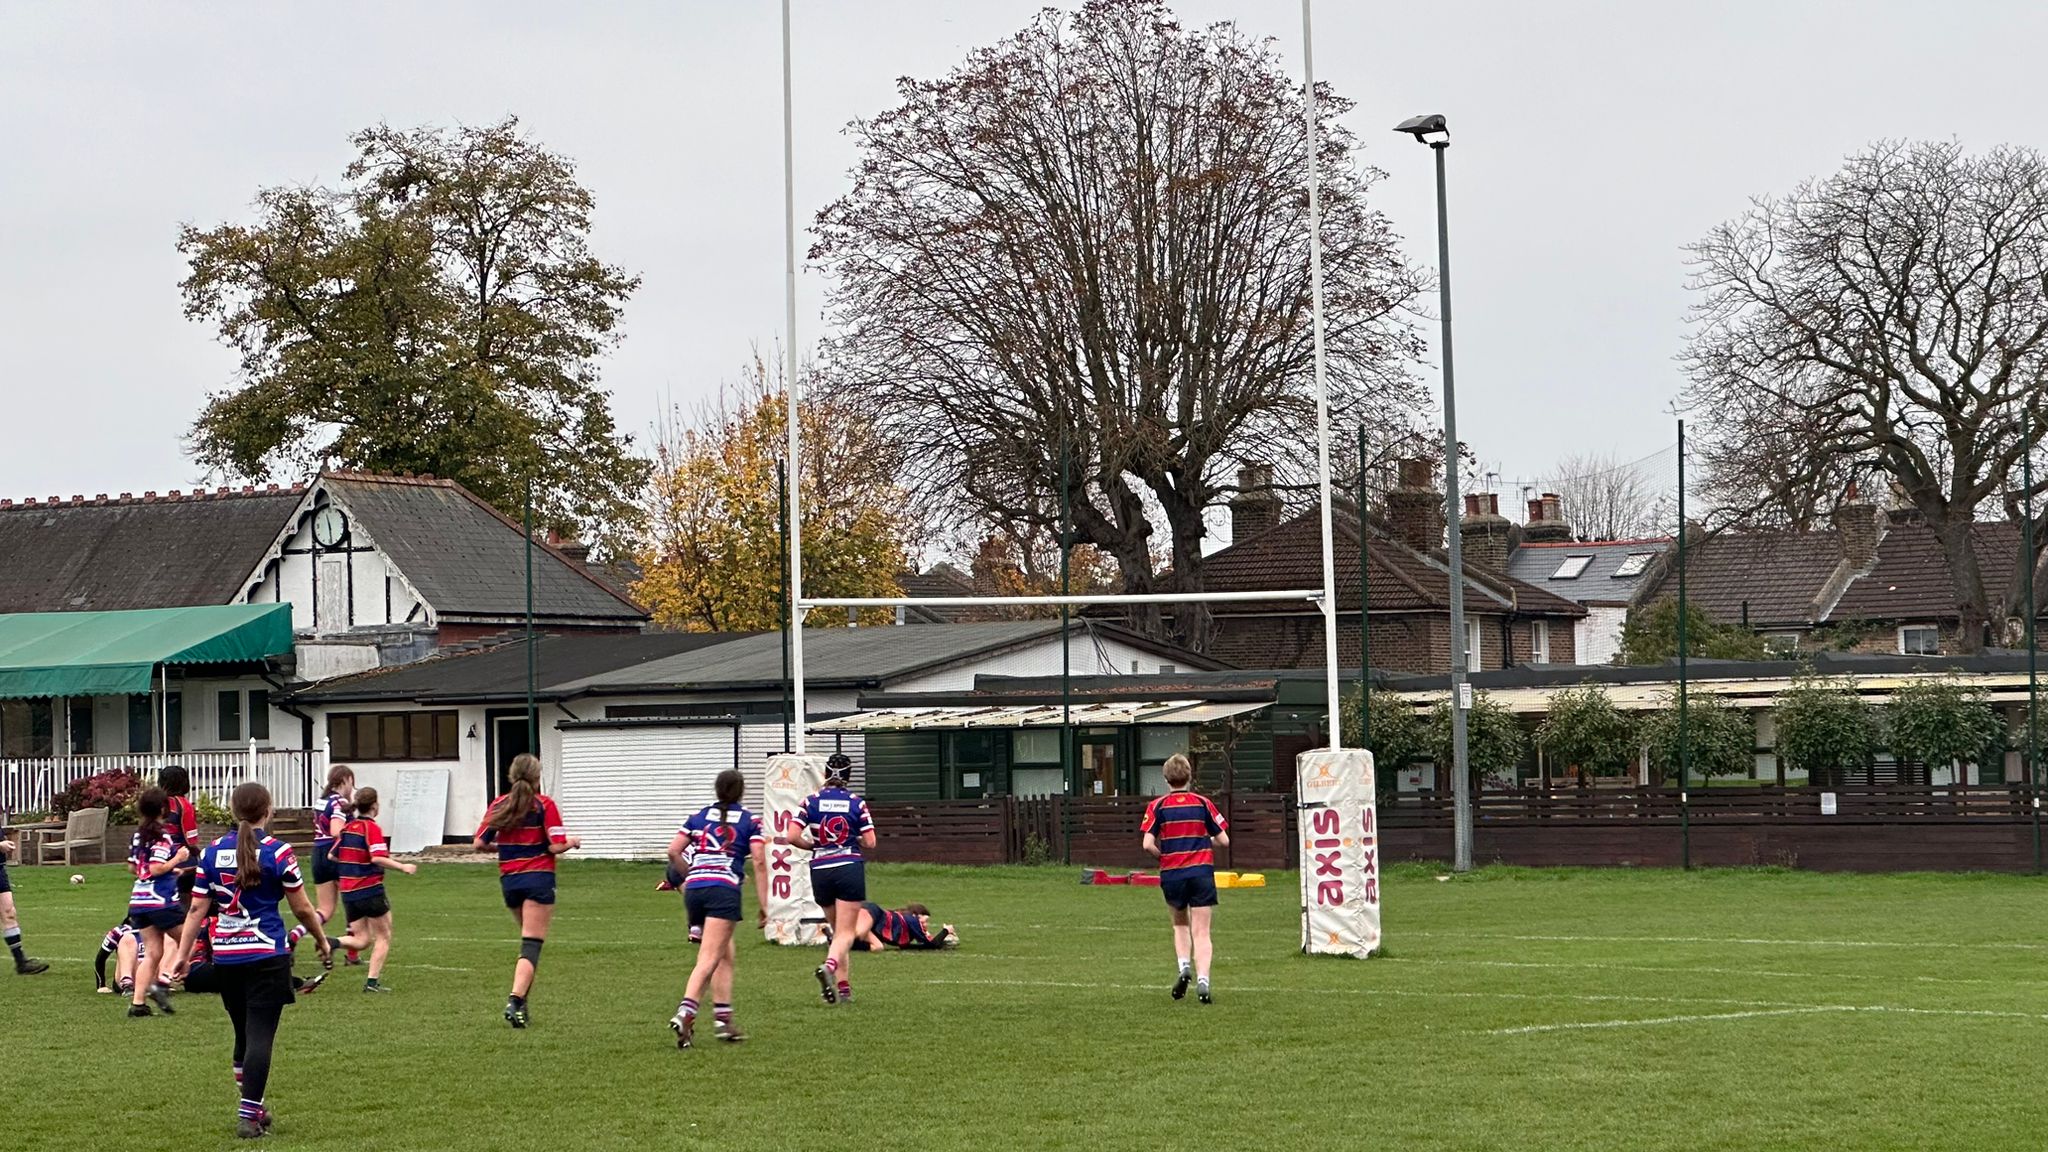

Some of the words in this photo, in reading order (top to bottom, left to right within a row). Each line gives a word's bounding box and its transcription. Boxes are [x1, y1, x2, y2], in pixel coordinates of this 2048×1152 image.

[772, 810, 793, 900] axis
[1313, 809, 1344, 907] axis
[1362, 807, 1377, 905] axis
